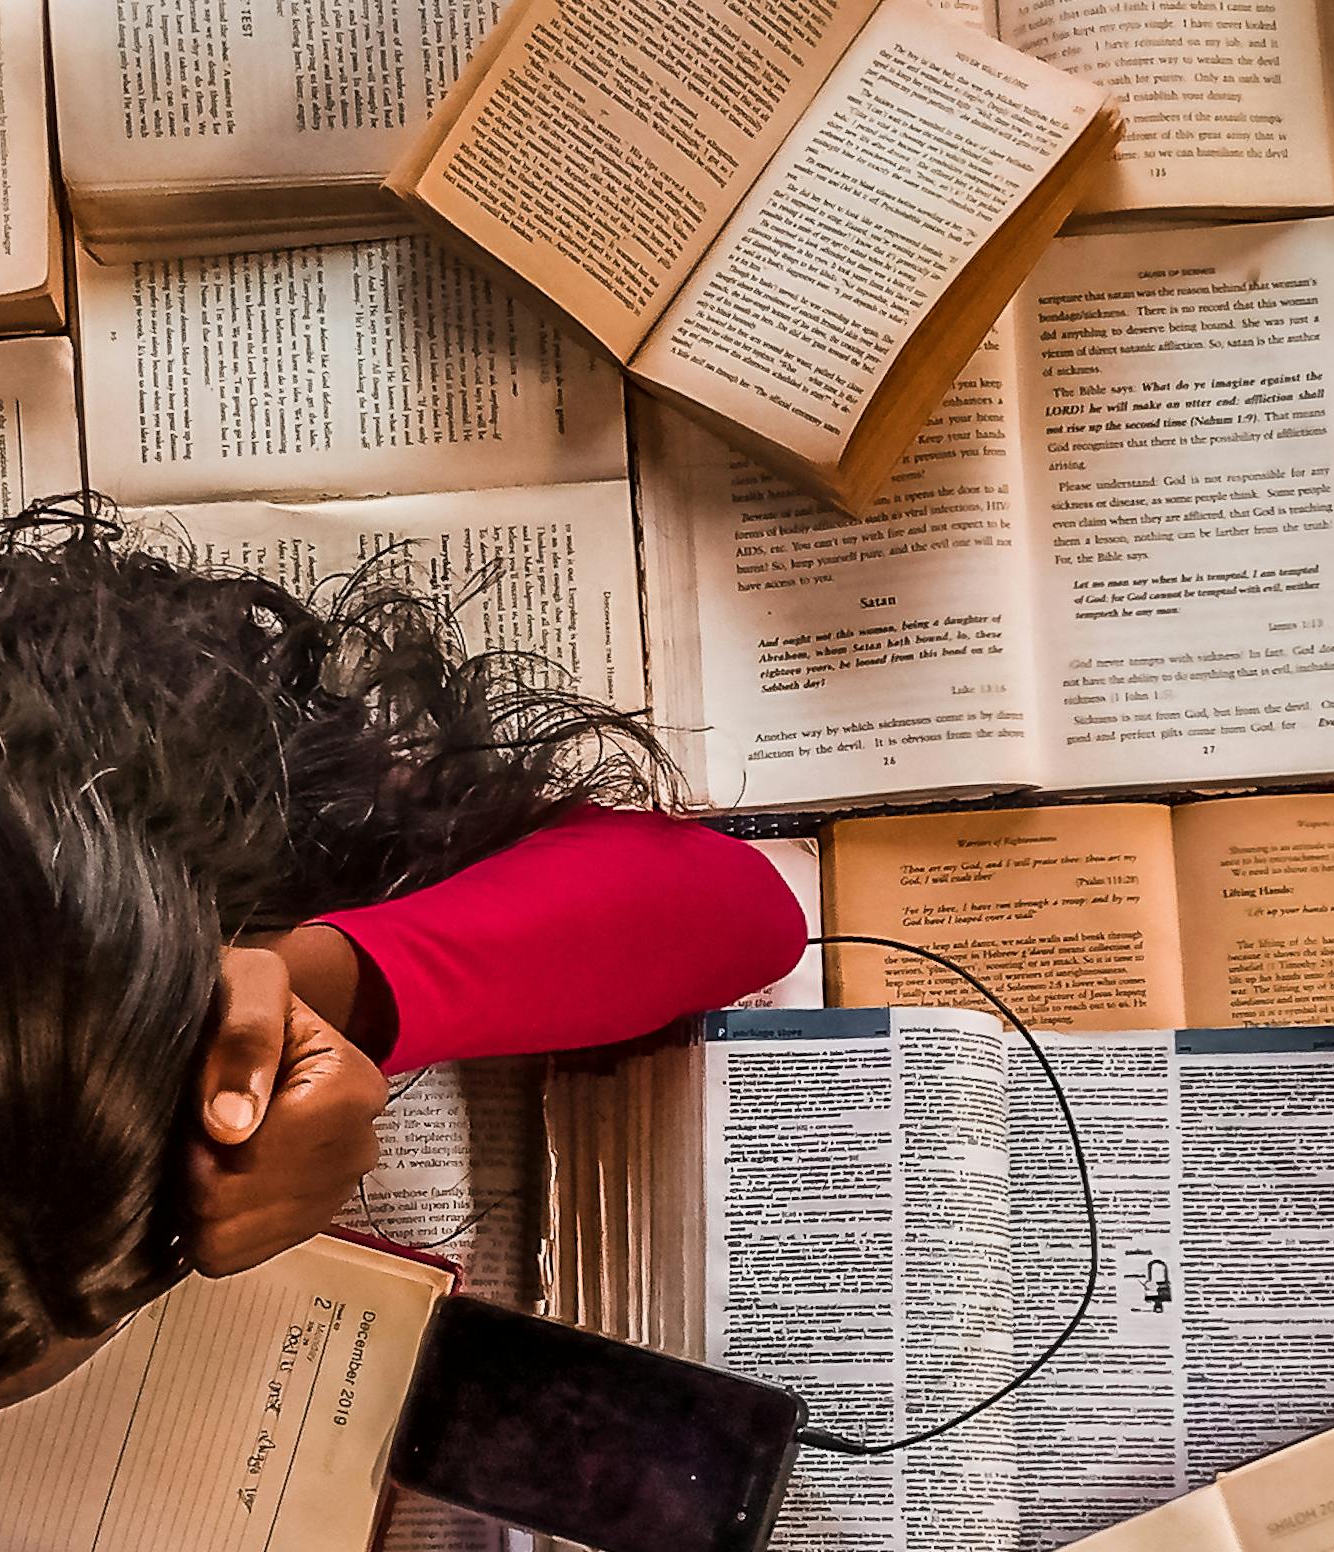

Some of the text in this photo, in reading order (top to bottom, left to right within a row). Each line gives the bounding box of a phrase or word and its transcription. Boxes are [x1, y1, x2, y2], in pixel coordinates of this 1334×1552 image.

[240, 9, 254, 38] TEST
[1194, 72, 1220, 84] Only
[1223, 75, 1235, 83] an
[1263, 74, 1281, 84] will
[1137, 295, 1319, 317] There is no record that this woman
[1053, 387, 1074, 399] The
[1079, 385, 1107, 397] Bible
[1142, 381, 1171, 392] What
[1176, 380, 1189, 389] do
[1194, 379, 1206, 391] ye
[1211, 376, 1256, 389] imagine
[1260, 373, 1300, 386] against
[1306, 371, 1323, 382] the
[1089, 404, 1102, 415] he
[1107, 401, 1128, 412] will
[1132, 400, 1162, 411] make
[1166, 400, 1181, 409] an
[1244, 392, 1294, 406] affliction
[1299, 389, 1325, 401] shall
[1046, 425, 1064, 435] not
[1067, 423, 1086, 434] rise
[1089, 423, 1103, 434] up
[1106, 420, 1122, 430] the
[1125, 417, 1160, 430] second
[1164, 417, 1188, 428] time
[1264, 410, 1289, 422] That
[1292, 408, 1326, 418] means
[859, 594, 896, 609] Satan
[755, 721, 875, 743] Another way by which
[1202, 745, 1216, 755] 27
[883, 756, 896, 767] 26
[1223, 885, 1295, 899] Lifting Hands:
[314, 1296, 331, 1310] 2
[333, 1311, 376, 1426] December 2019
[1266, 1508, 1318, 1536] SHILOH
